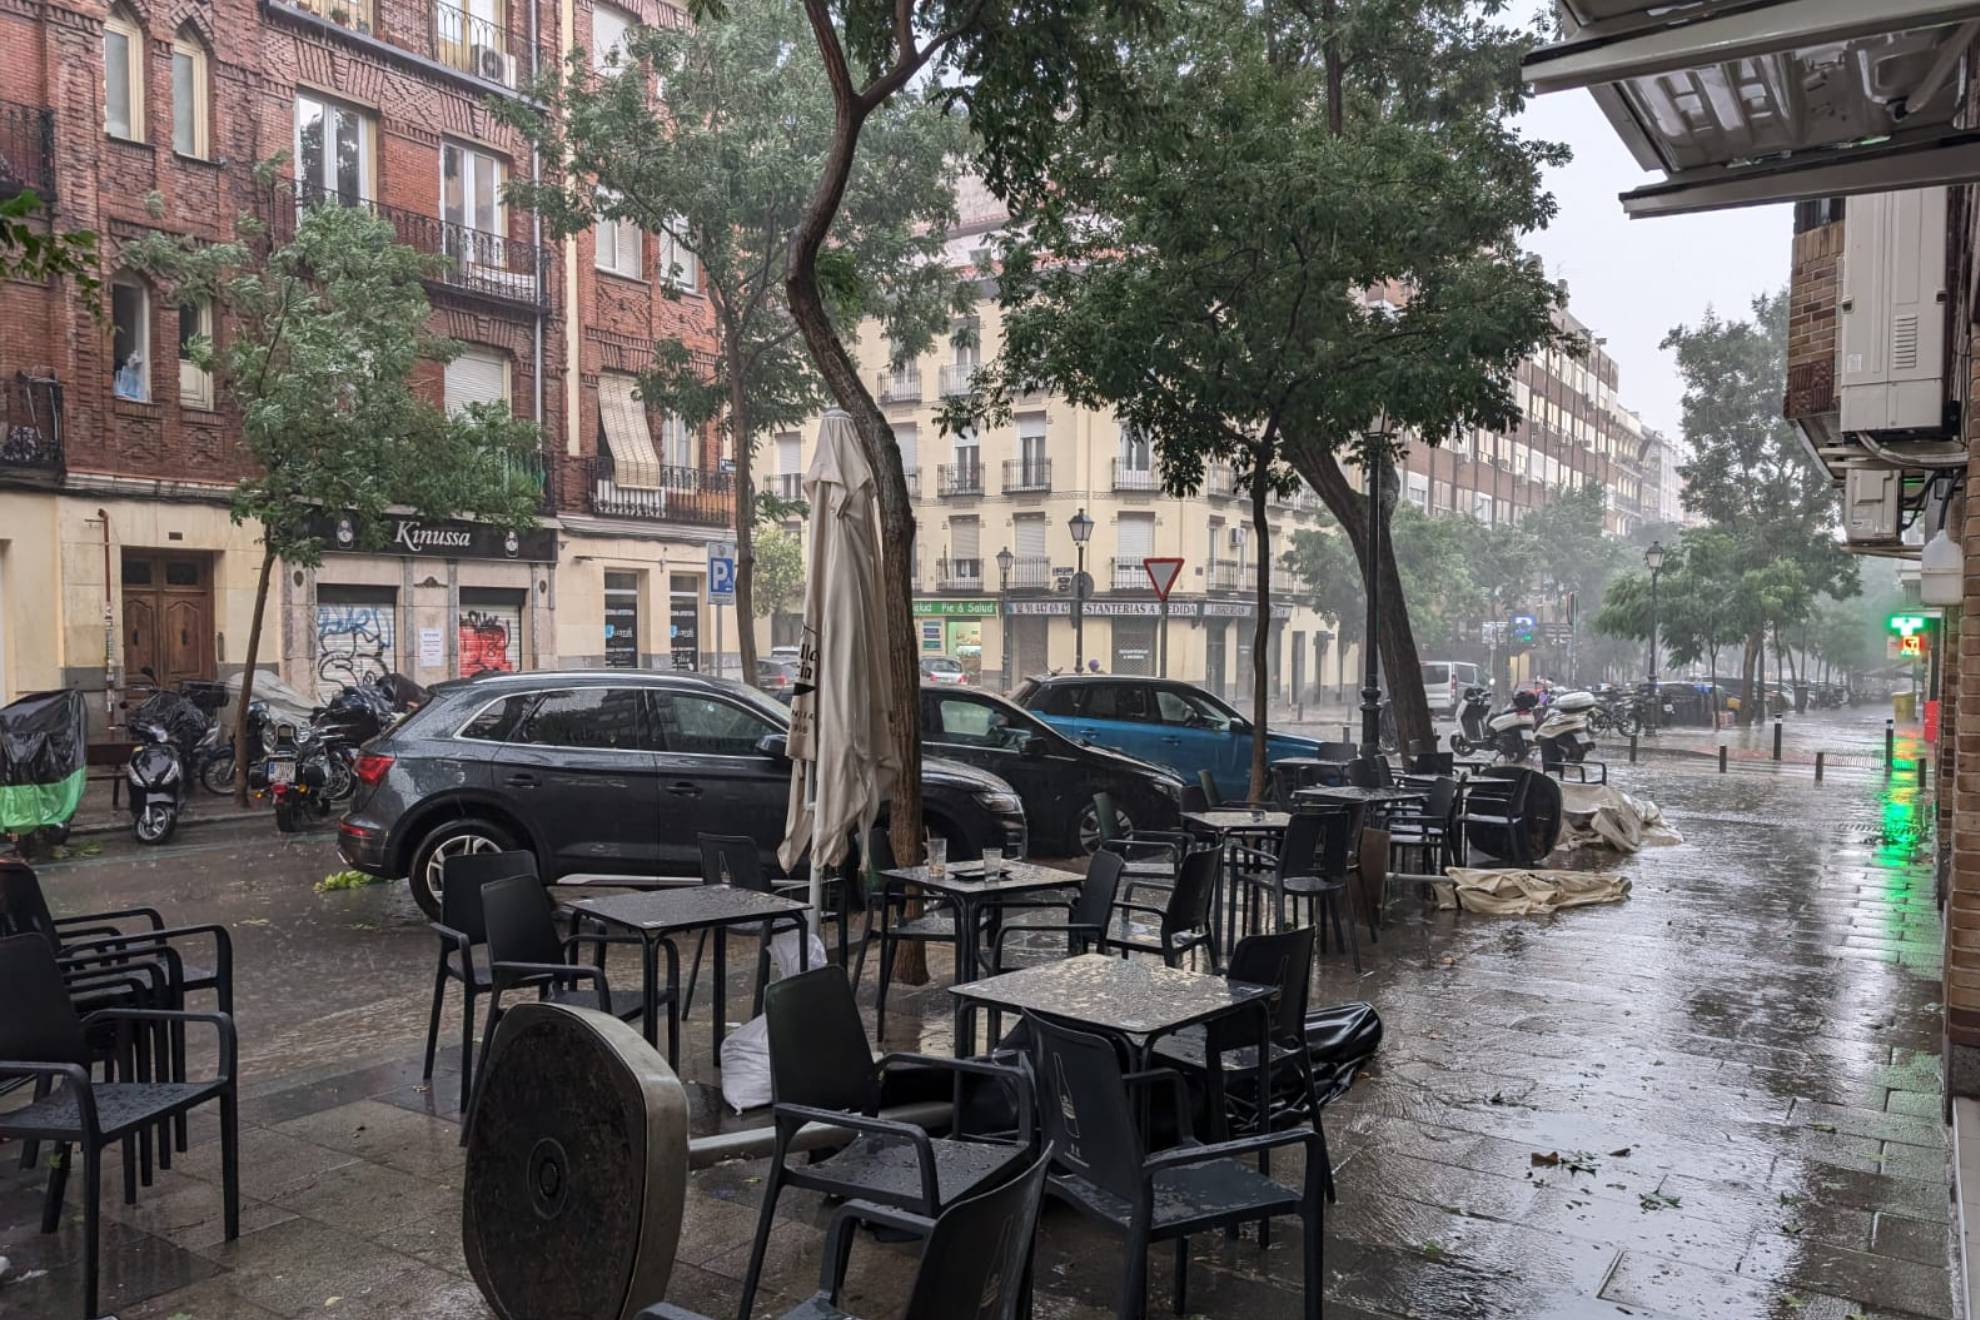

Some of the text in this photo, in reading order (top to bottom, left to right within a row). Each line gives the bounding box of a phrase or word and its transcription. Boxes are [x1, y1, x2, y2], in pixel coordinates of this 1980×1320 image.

[394, 521, 471, 551] Kinussa
[712, 560, 728, 590] P
[912, 601, 932, 612] alud
[967, 602, 993, 613] Salud
[1159, 603, 1197, 614] EDIDA
